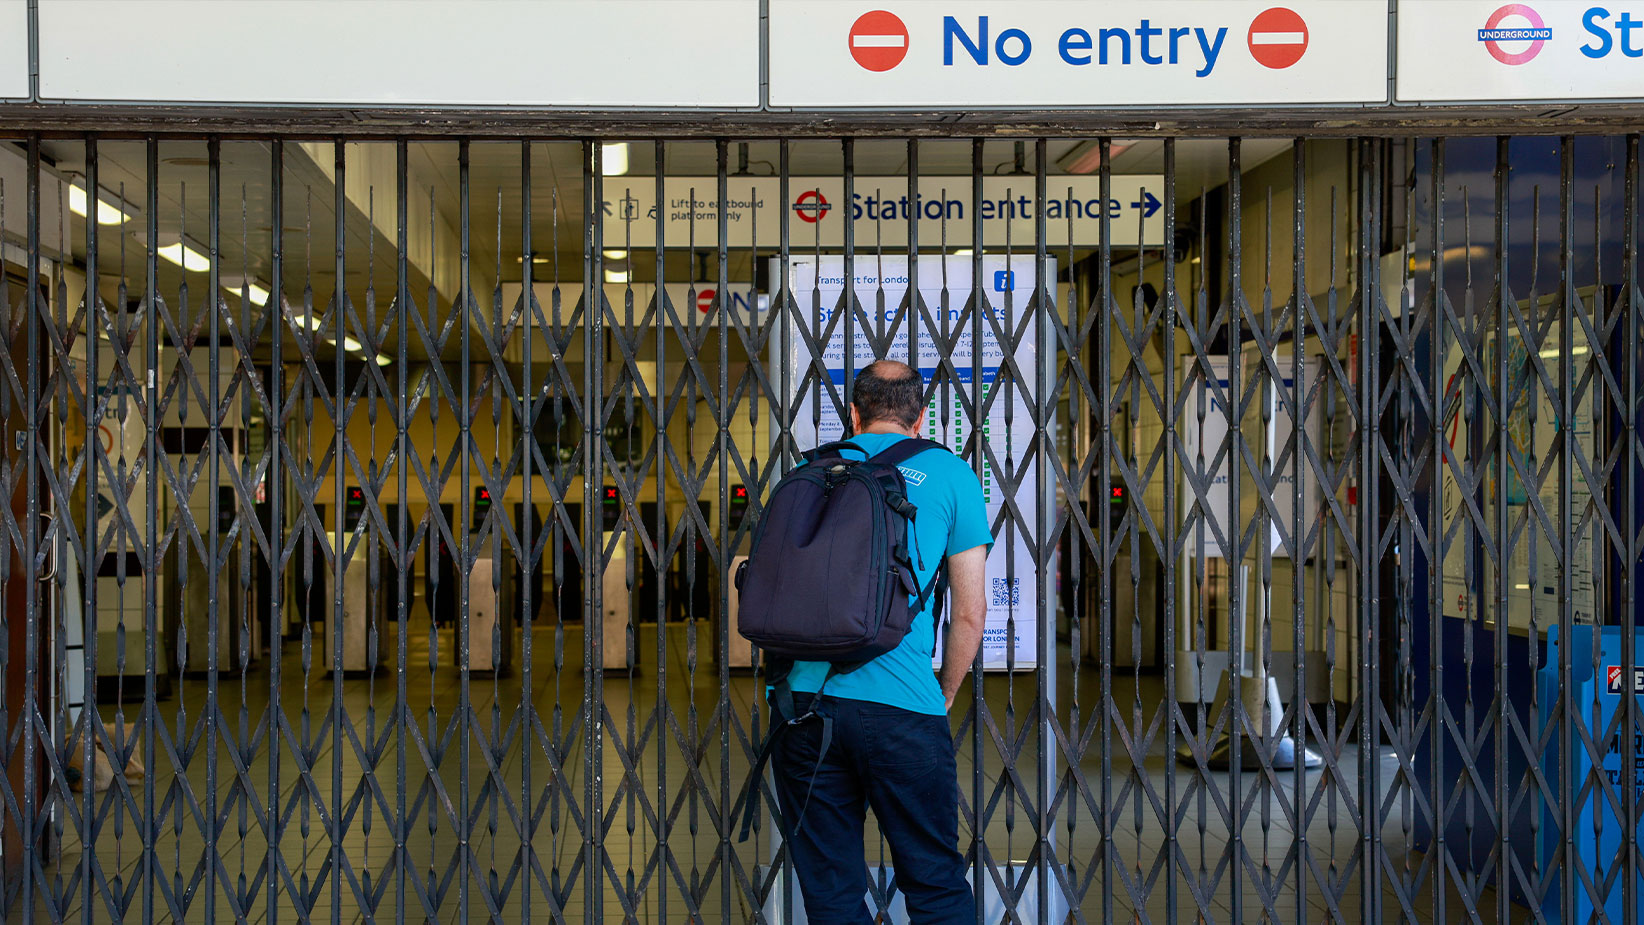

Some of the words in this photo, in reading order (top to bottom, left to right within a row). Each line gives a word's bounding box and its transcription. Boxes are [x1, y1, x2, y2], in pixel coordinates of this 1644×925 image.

[1479, 30, 1551, 39] UNDERGROUND
[1579, 7, 1643, 59] St
[943, 16, 1032, 66] No
[1058, 20, 1229, 78] entry
[671, 199, 690, 209] Lift
[694, 200, 705, 209] to
[709, 199, 764, 209] eatbound
[852, 193, 963, 220] Station
[982, 196, 1121, 219] entance
[671, 211, 716, 221] platorm
[725, 211, 741, 222] nly
[818, 276, 860, 286] Transprt
[863, 276, 877, 284] for
[880, 276, 910, 284] Londo
